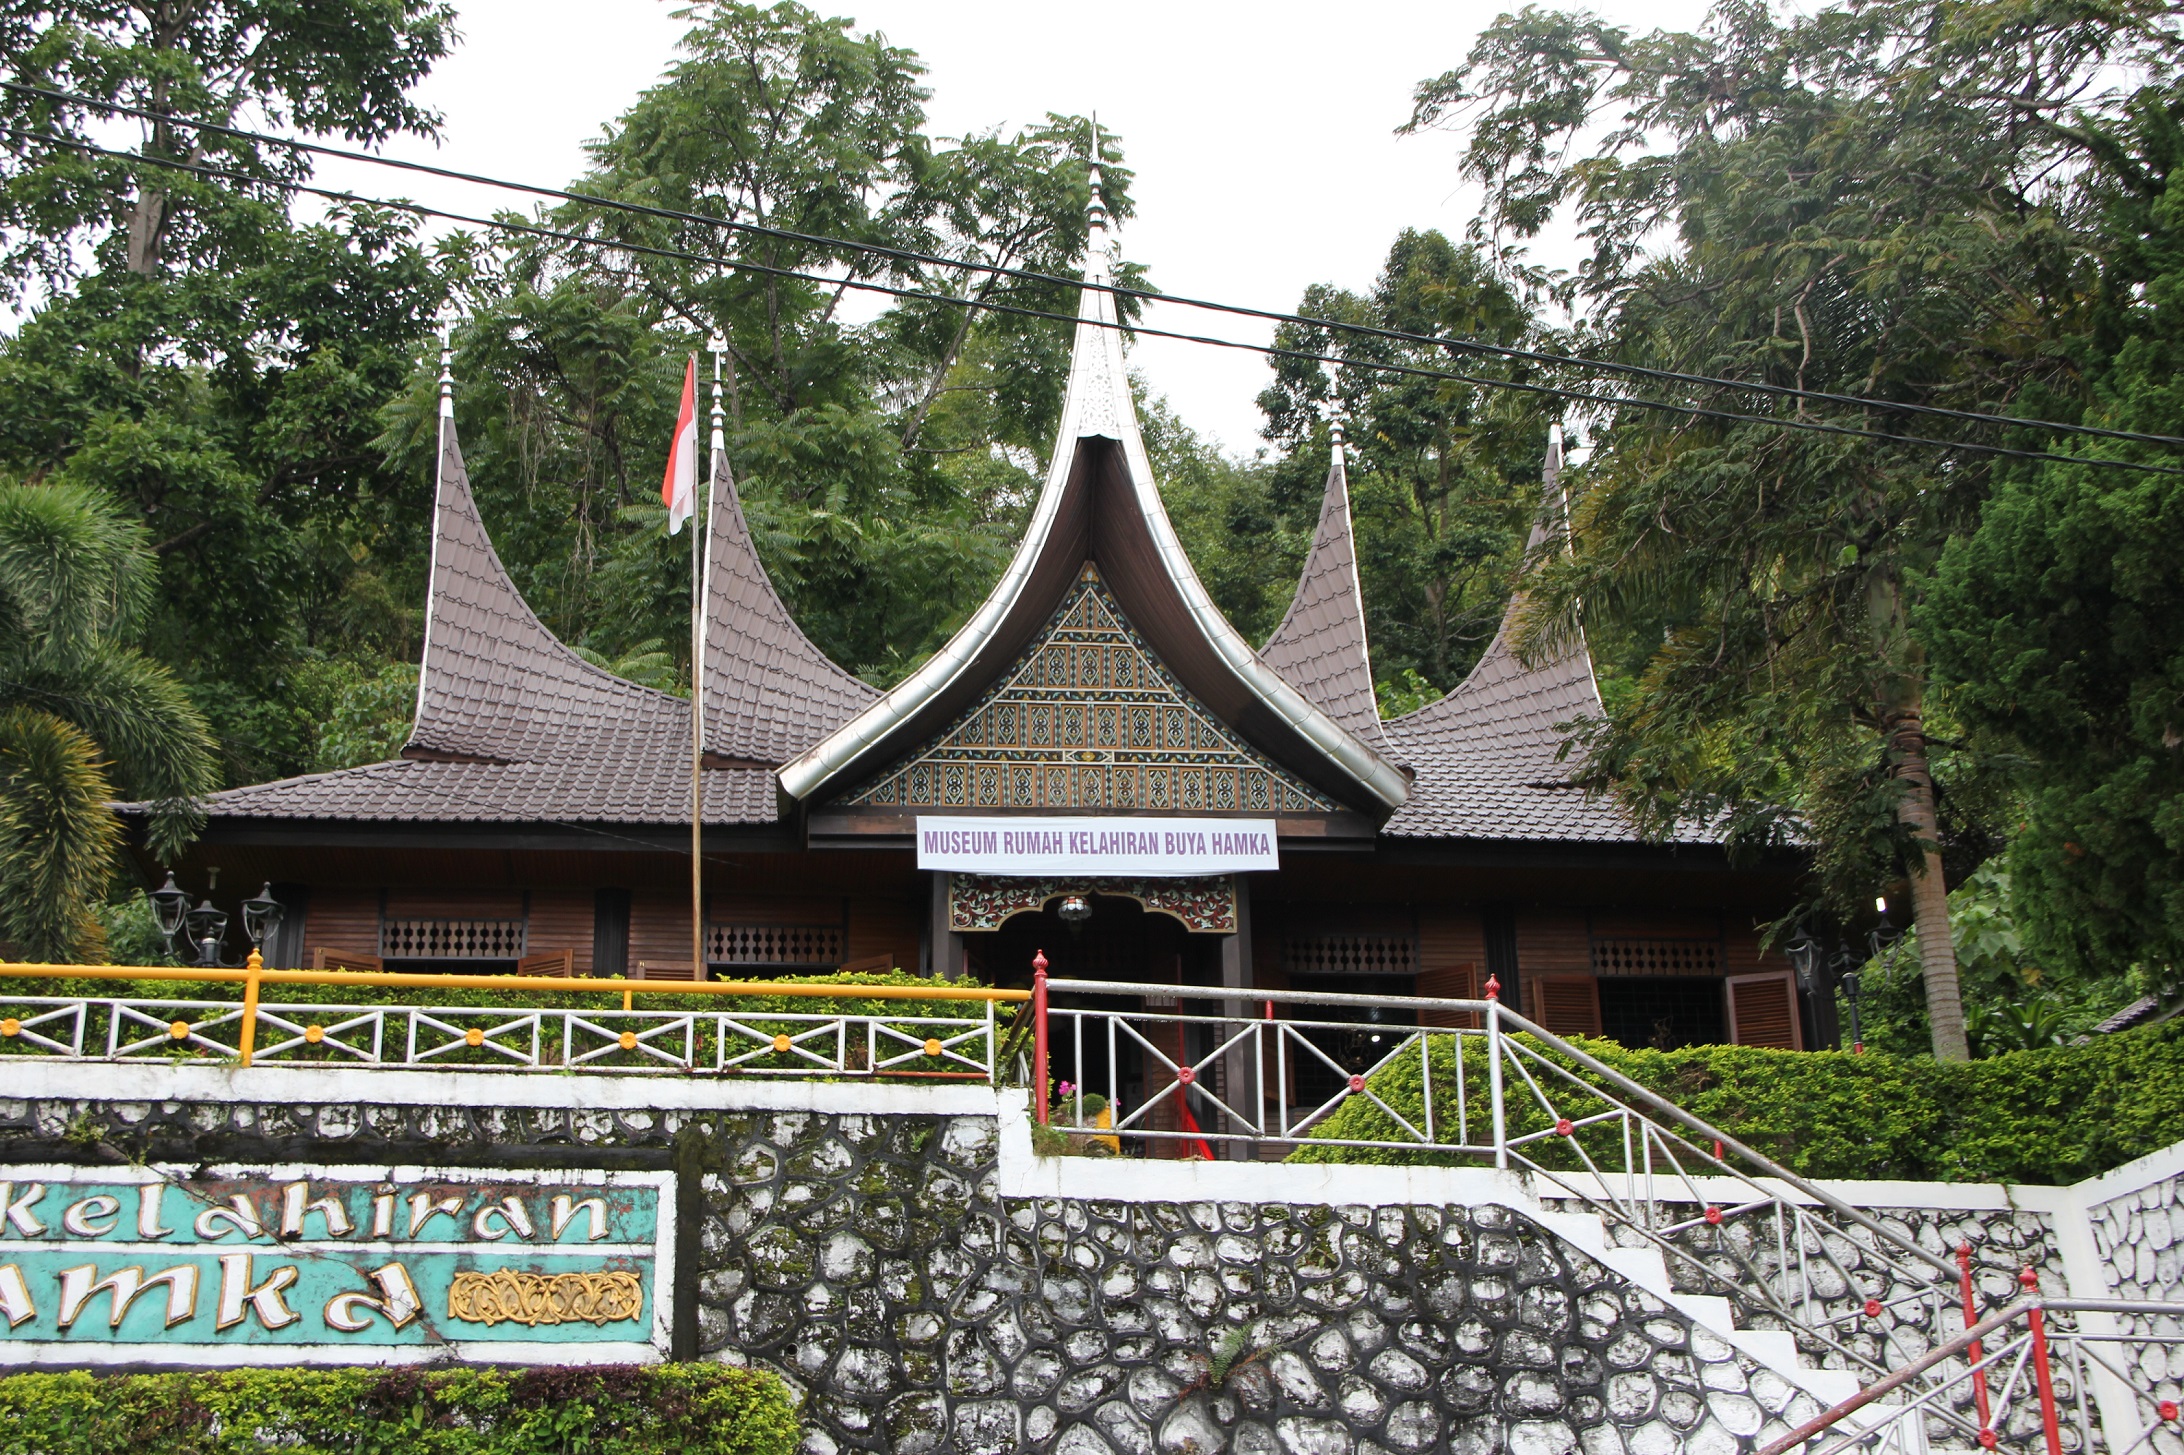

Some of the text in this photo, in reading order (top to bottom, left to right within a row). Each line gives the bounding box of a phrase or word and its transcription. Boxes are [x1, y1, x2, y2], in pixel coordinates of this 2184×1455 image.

[924, 830, 1271, 856] MUSEUM RUMAH KELAHIRAN BUYA HAMKA
